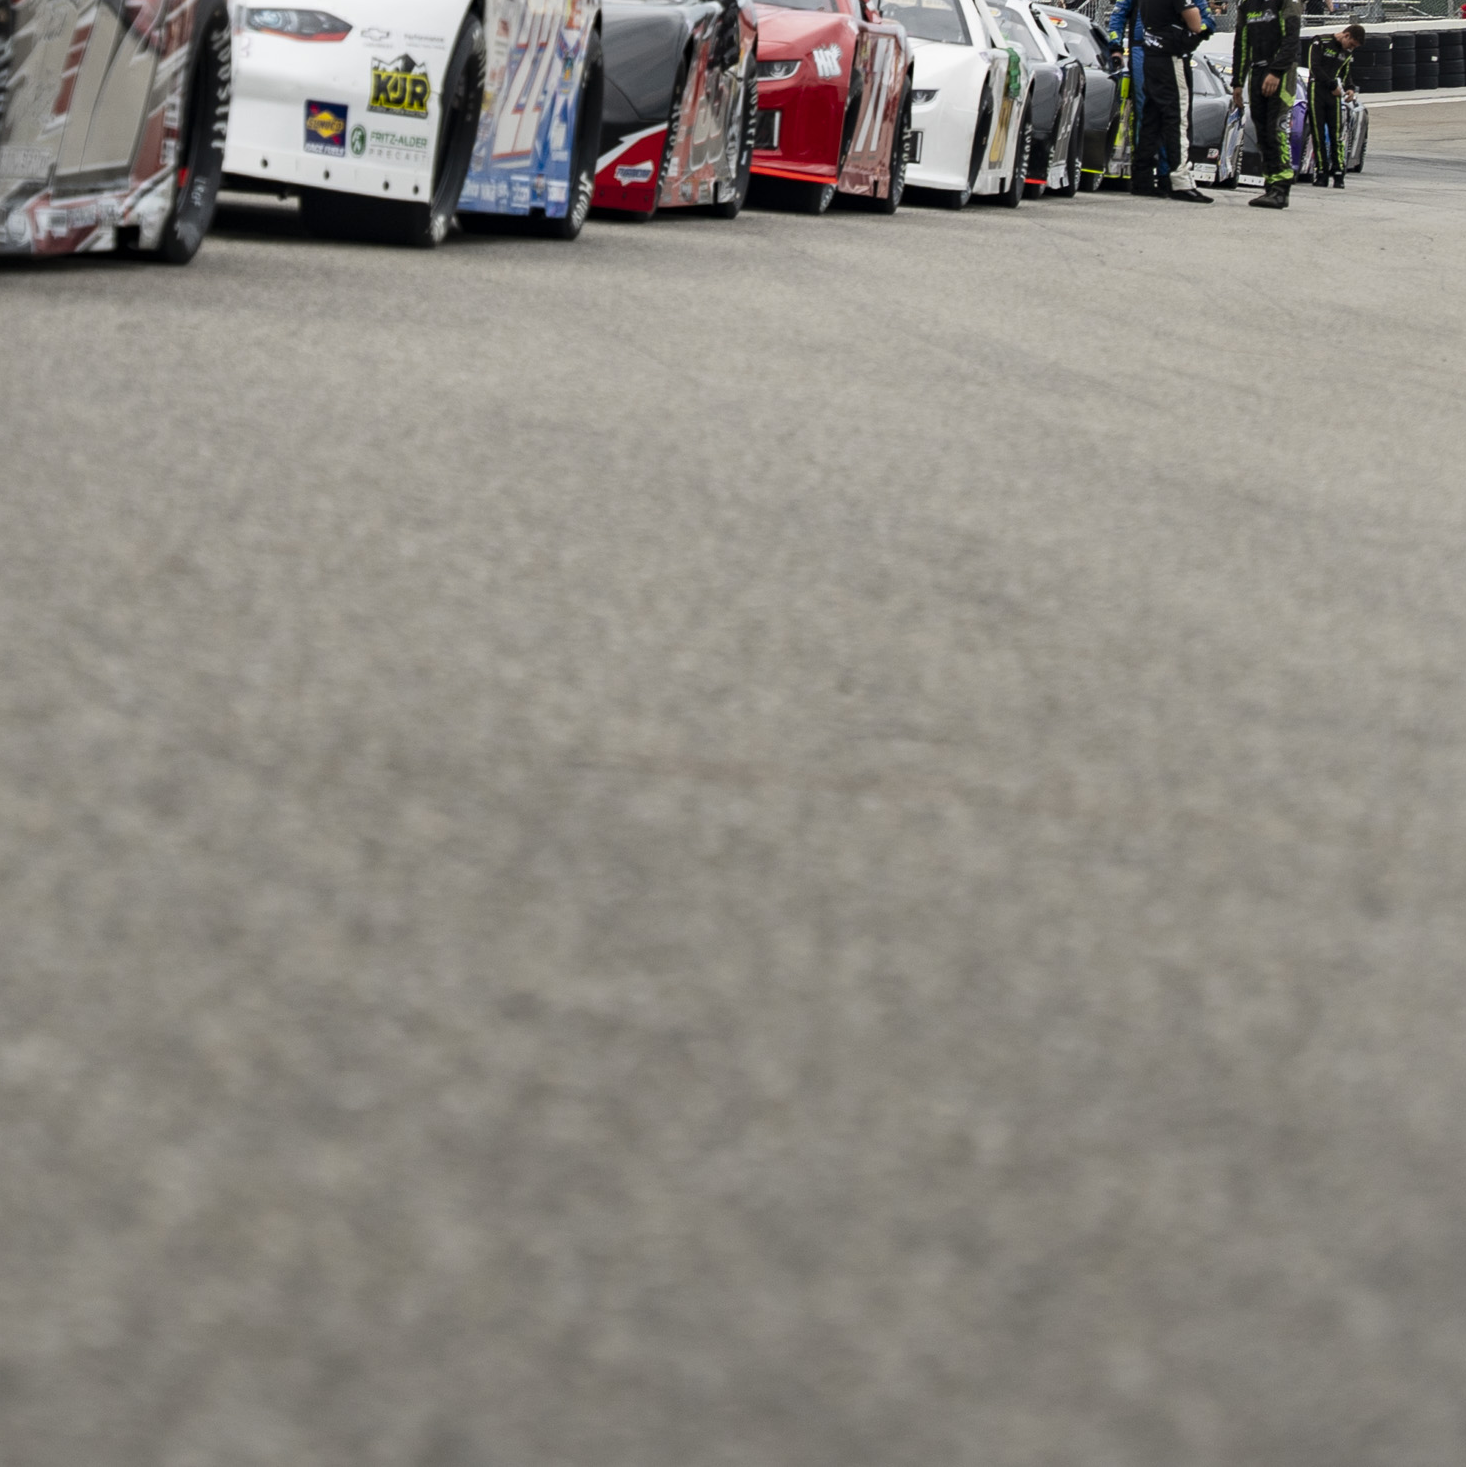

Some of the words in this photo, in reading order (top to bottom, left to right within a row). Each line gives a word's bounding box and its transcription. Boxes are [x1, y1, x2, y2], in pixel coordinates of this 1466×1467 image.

[372, 73, 429, 111] KJR
[307, 117, 344, 131] SUNOCO
[371, 131, 428, 148] FRITZ-ALDER
[369, 148, 427, 161] PRECAST
